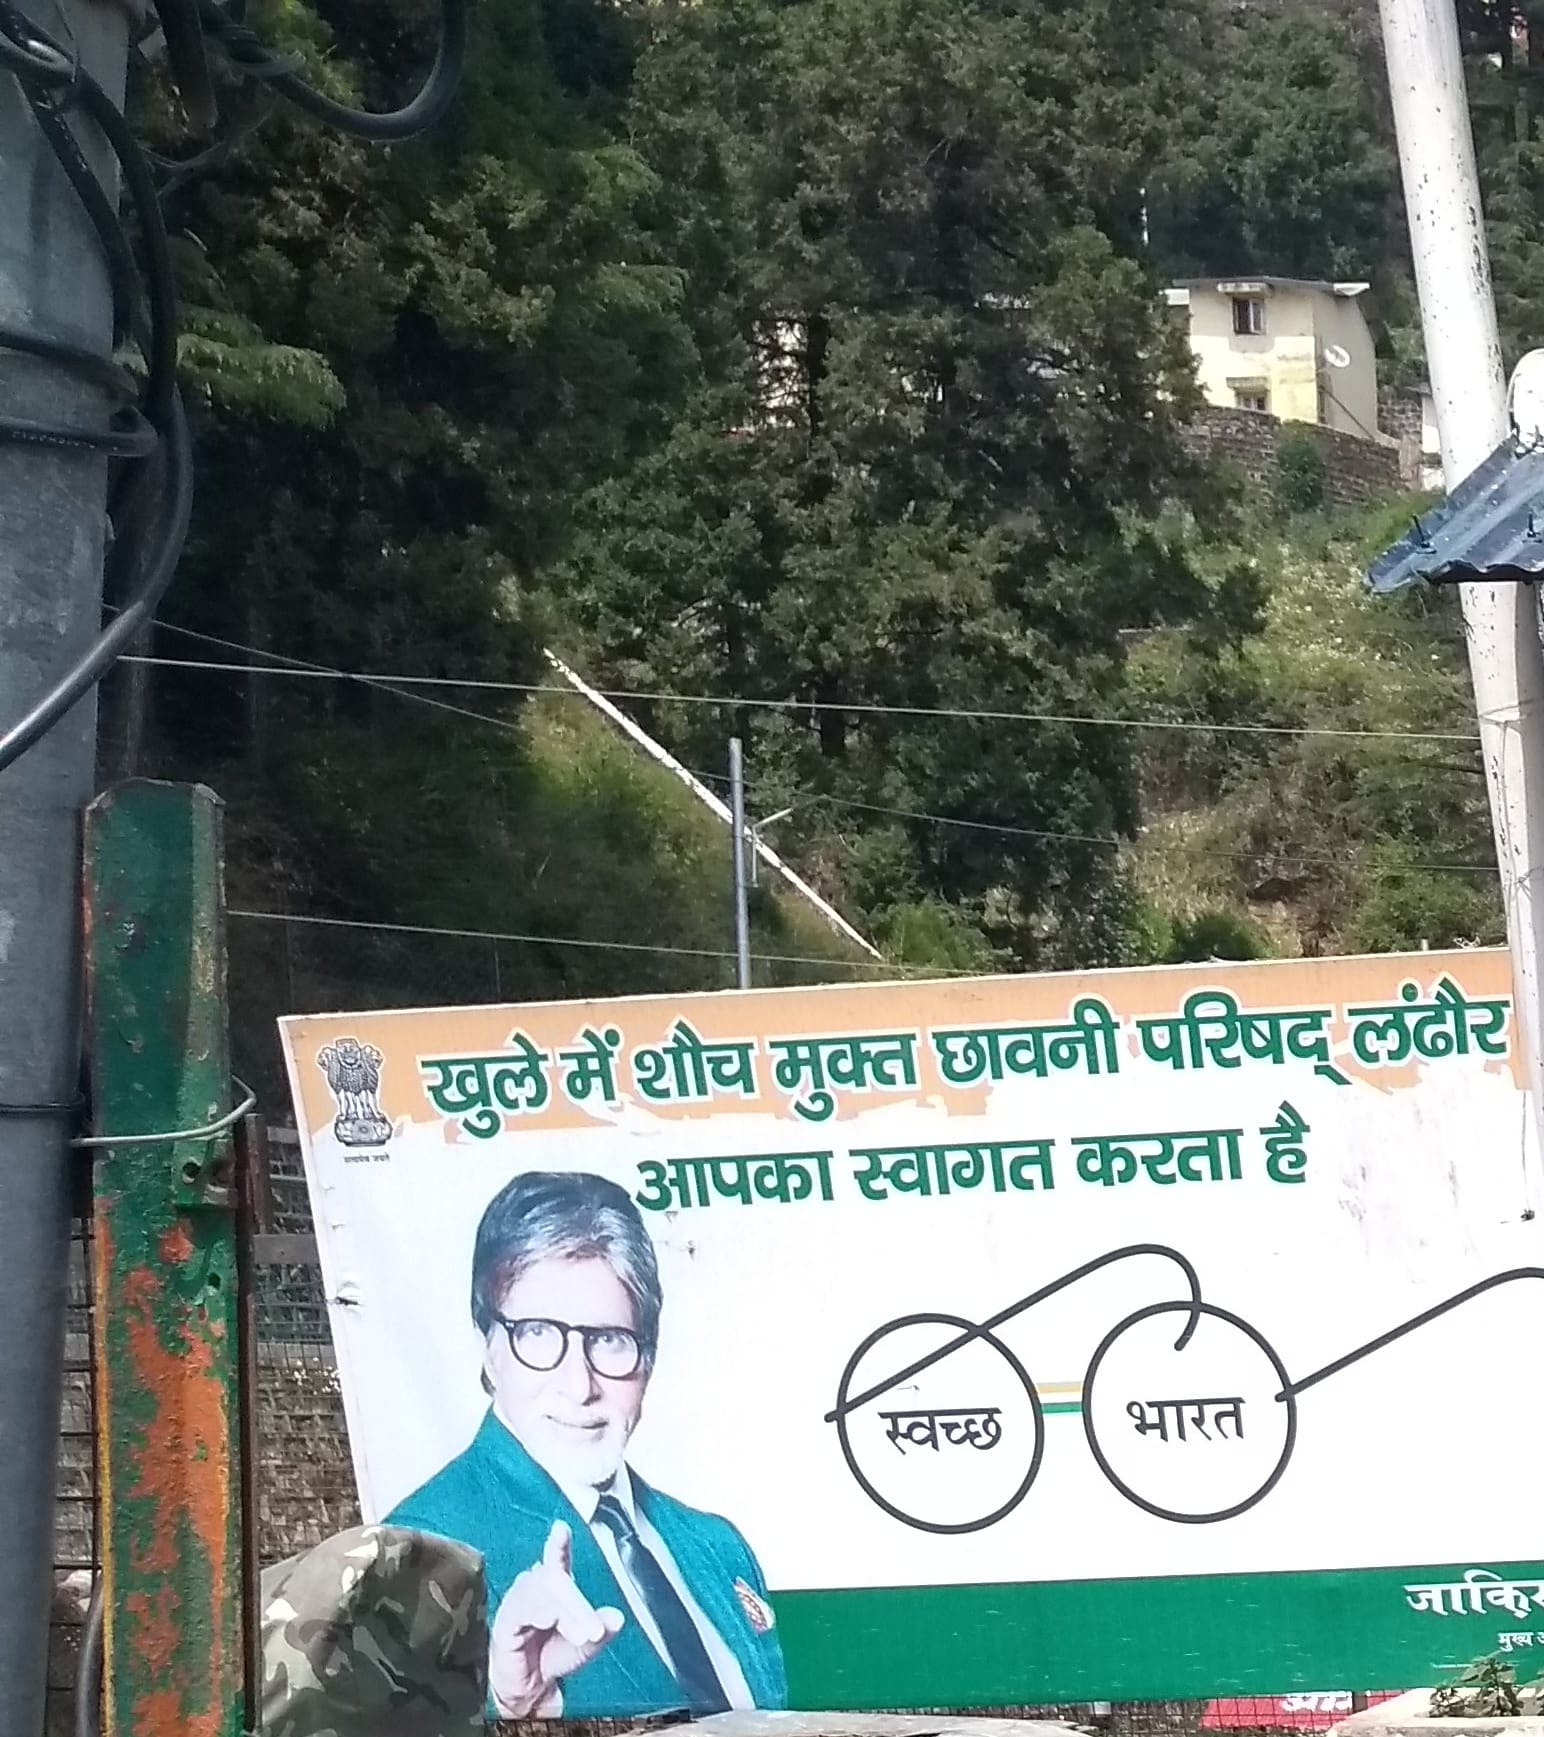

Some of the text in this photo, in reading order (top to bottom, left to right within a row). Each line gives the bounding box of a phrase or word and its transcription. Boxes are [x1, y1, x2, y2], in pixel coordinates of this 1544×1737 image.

[422, 976, 1511, 1140] खुले में शौच मुक्त छावनी परिषद् लंढौर
[637, 1100, 1311, 1211] आपका स्वागत करता है
[878, 1407, 1002, 1455] स्वच्छ
[1126, 1396, 1246, 1442] भारत
[1498, 1631, 1534, 1652] मुख्य
